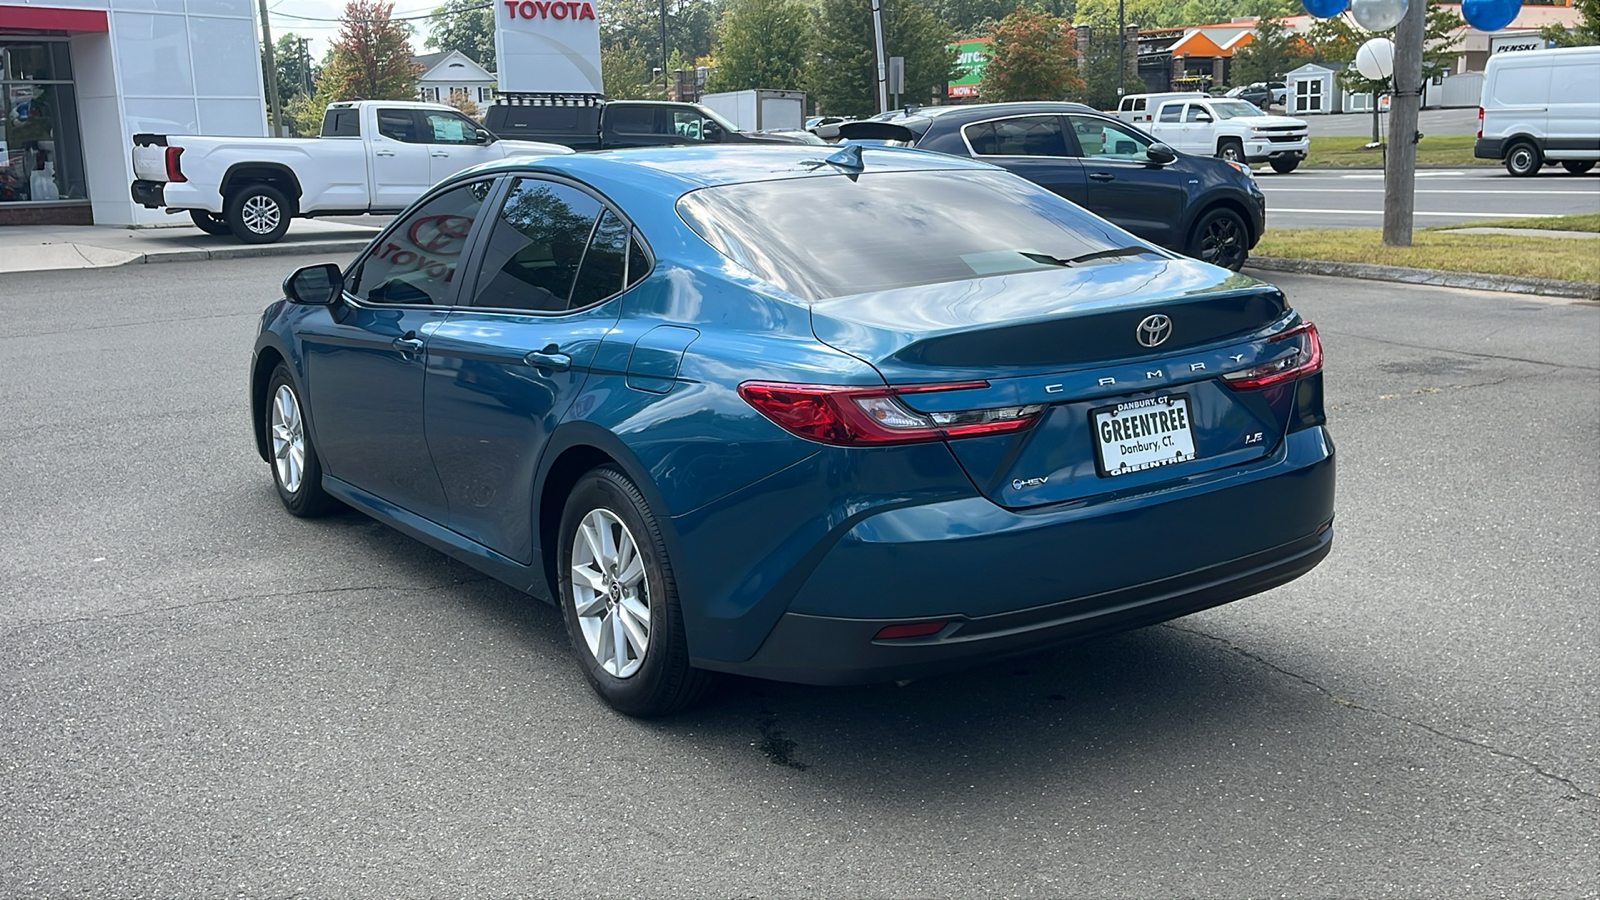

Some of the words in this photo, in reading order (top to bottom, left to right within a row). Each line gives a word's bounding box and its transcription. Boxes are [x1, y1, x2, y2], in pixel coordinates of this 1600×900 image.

[504, 0, 596, 20] TOYOTA
[1497, 43, 1539, 53] PENSKE
[953, 87, 971, 95] NOW
[1045, 353, 1244, 393] CAMRY
[1117, 398, 1157, 411] DANBURY,
[1158, 396, 1168, 405] CT
[1101, 407, 1187, 444] GREENTREE
[1120, 440, 1160, 455] Danbury,
[1162, 436, 1174, 447] CT.
[1245, 432, 1263, 444] LE
[1110, 453, 1195, 477] GREENTREE
